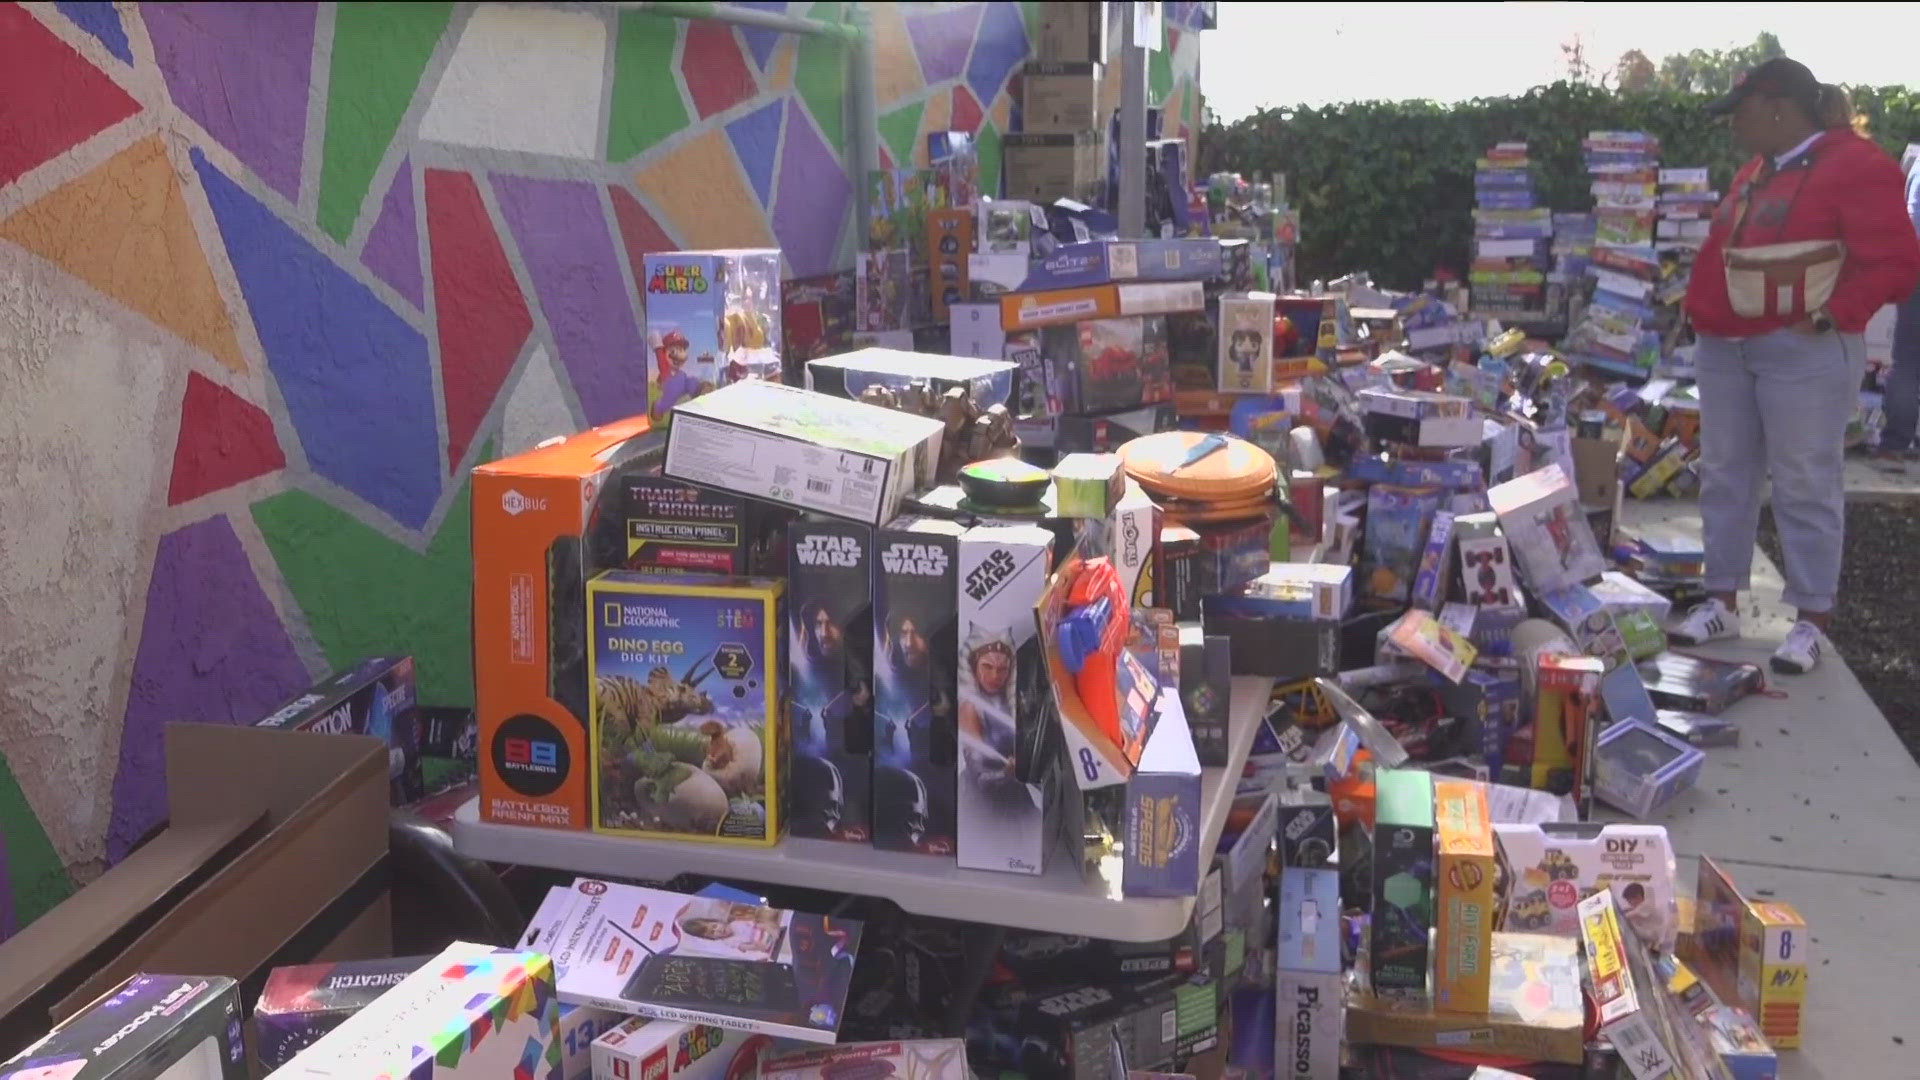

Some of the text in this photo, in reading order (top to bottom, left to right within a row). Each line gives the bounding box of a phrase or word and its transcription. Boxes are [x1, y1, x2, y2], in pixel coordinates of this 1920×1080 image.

[655, 264, 702, 278] SUPER
[648, 276, 708, 294] MARIO
[502, 495, 547, 511] HEXBUG
[648, 501, 737, 518] FORMERS
[635, 523, 693, 537] INSTRUCTION
[796, 534, 861, 551] STAR
[797, 549, 861, 568] WARS
[881, 543, 948, 560] STAR
[882, 557, 948, 576] WARS
[965, 549, 1013, 594] STAR
[969, 557, 1016, 602] WARS
[623, 606, 669, 618] NATIONAL
[623, 617, 681, 629] GEOGRAPHIC
[716, 614, 755, 629] STEM
[608, 637, 685, 654] DINO EGG
[621, 652, 671, 665] DIG KIT
[727, 653, 738, 667] 2
[491, 798, 570, 816] BATTLEBOX
[540, 813, 570, 825] MAX
[1605, 838, 1638, 853] DIY
[660, 1009, 754, 1031] LCD WRITING TABLET
